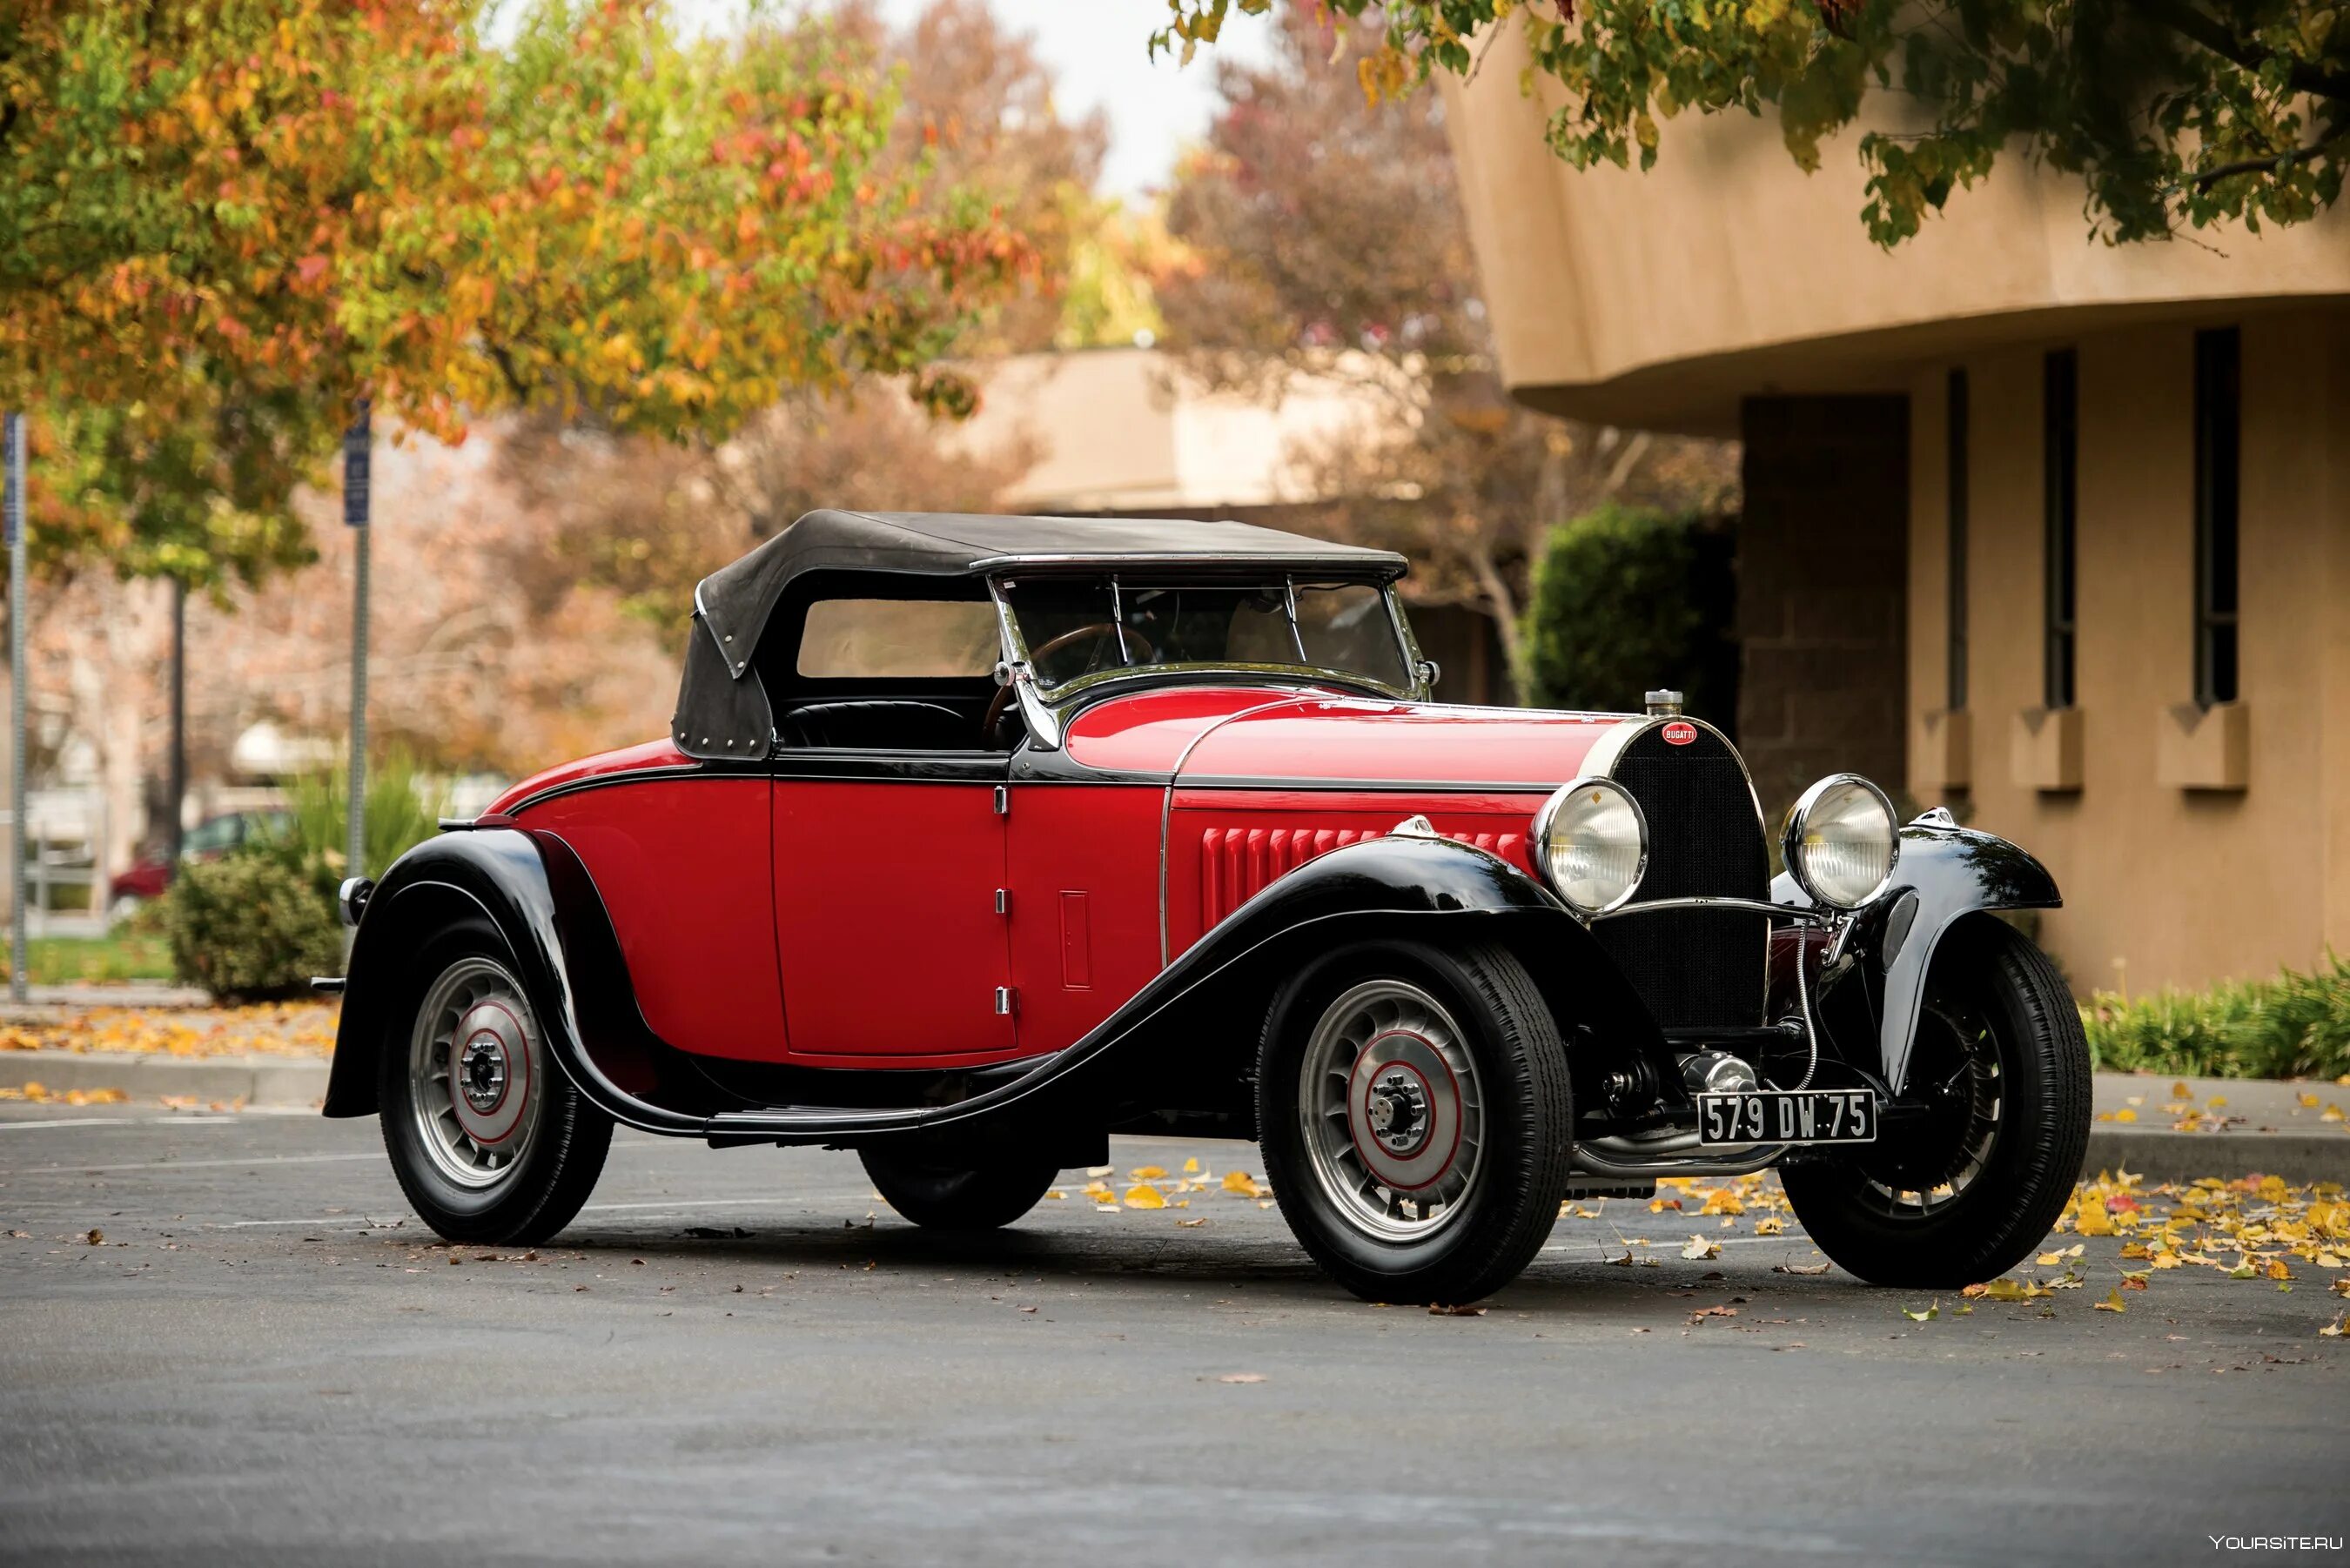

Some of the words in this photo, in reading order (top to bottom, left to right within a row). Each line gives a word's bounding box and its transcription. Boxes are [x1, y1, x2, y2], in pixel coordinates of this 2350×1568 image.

[1666, 730, 1695, 739] BUGATTI
[1707, 1097, 1764, 1140] 579
[1778, 1096, 1815, 1138] DW
[1829, 1095, 1865, 1137] 75
